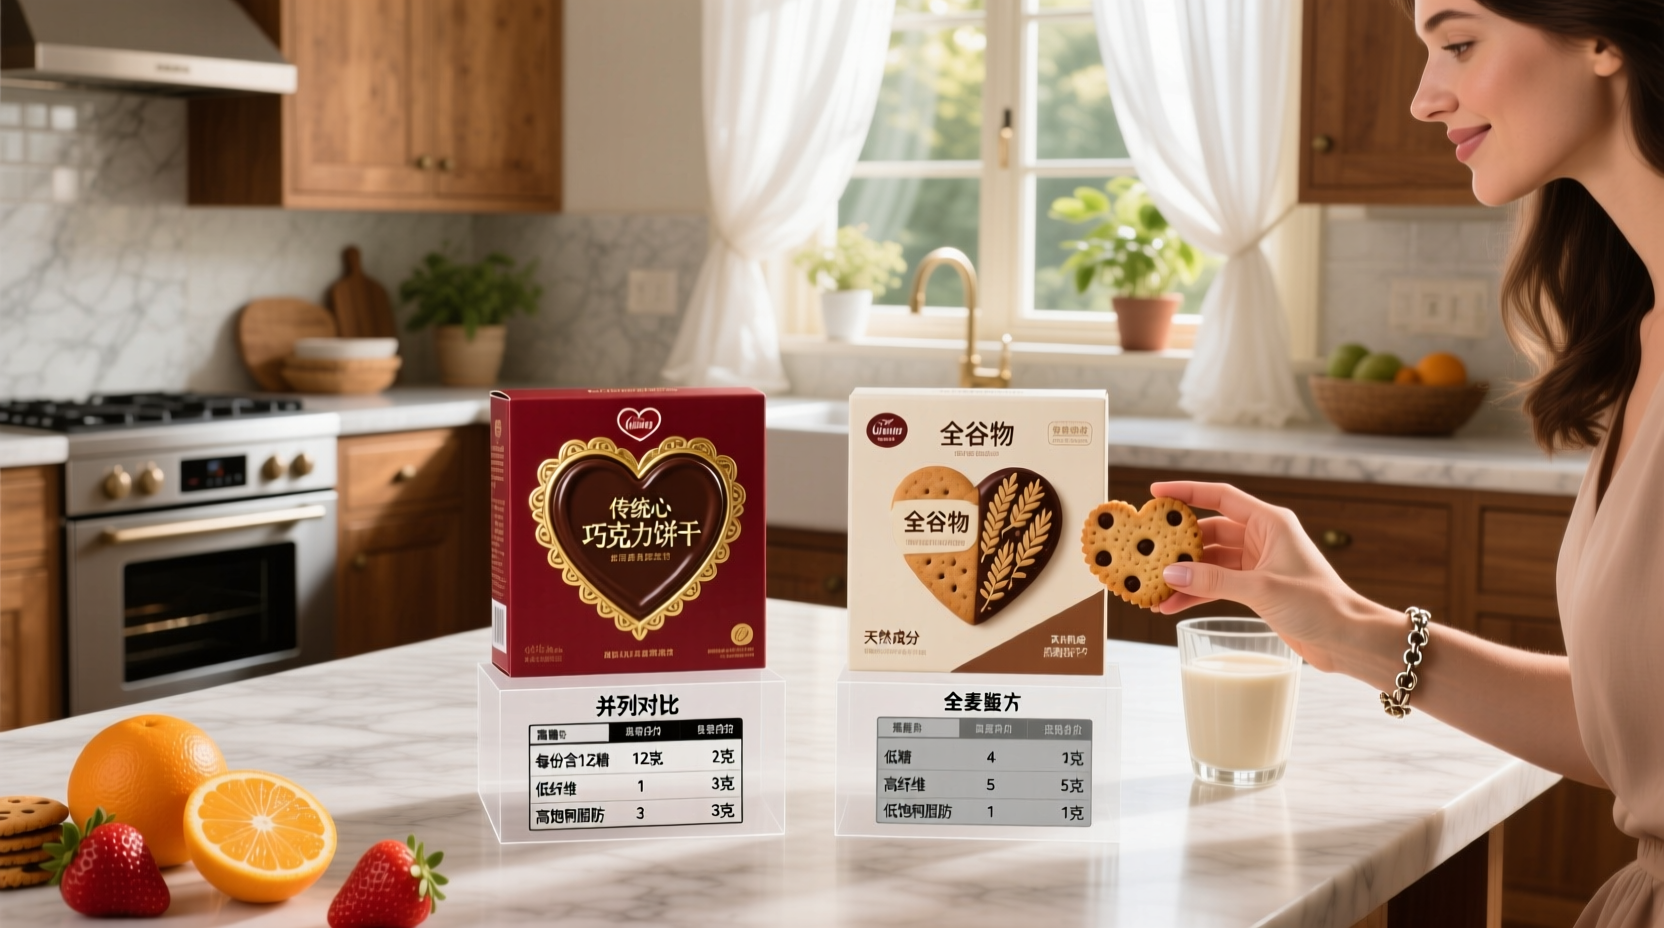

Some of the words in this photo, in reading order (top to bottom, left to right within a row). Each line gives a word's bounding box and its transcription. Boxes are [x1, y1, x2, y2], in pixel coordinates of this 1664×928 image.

[940, 420, 1015, 447] 全谷物
[609, 496, 672, 520] 传统心
[903, 510, 970, 534] 全谷物
[582, 520, 702, 549] 巧克力饼干
[596, 693, 680, 717] 并列对比
[712, 747, 735, 765] 2克
[987, 751, 996, 763] 4
[638, 780, 644, 792] 1
[711, 774, 735, 791] 3克
[986, 778, 995, 791] 5
[1060, 777, 1084, 793] 5克
[636, 807, 645, 820] 3
[711, 801, 735, 819] 3克
[987, 806, 994, 818] 1
[1061, 805, 1084, 821] 1克
